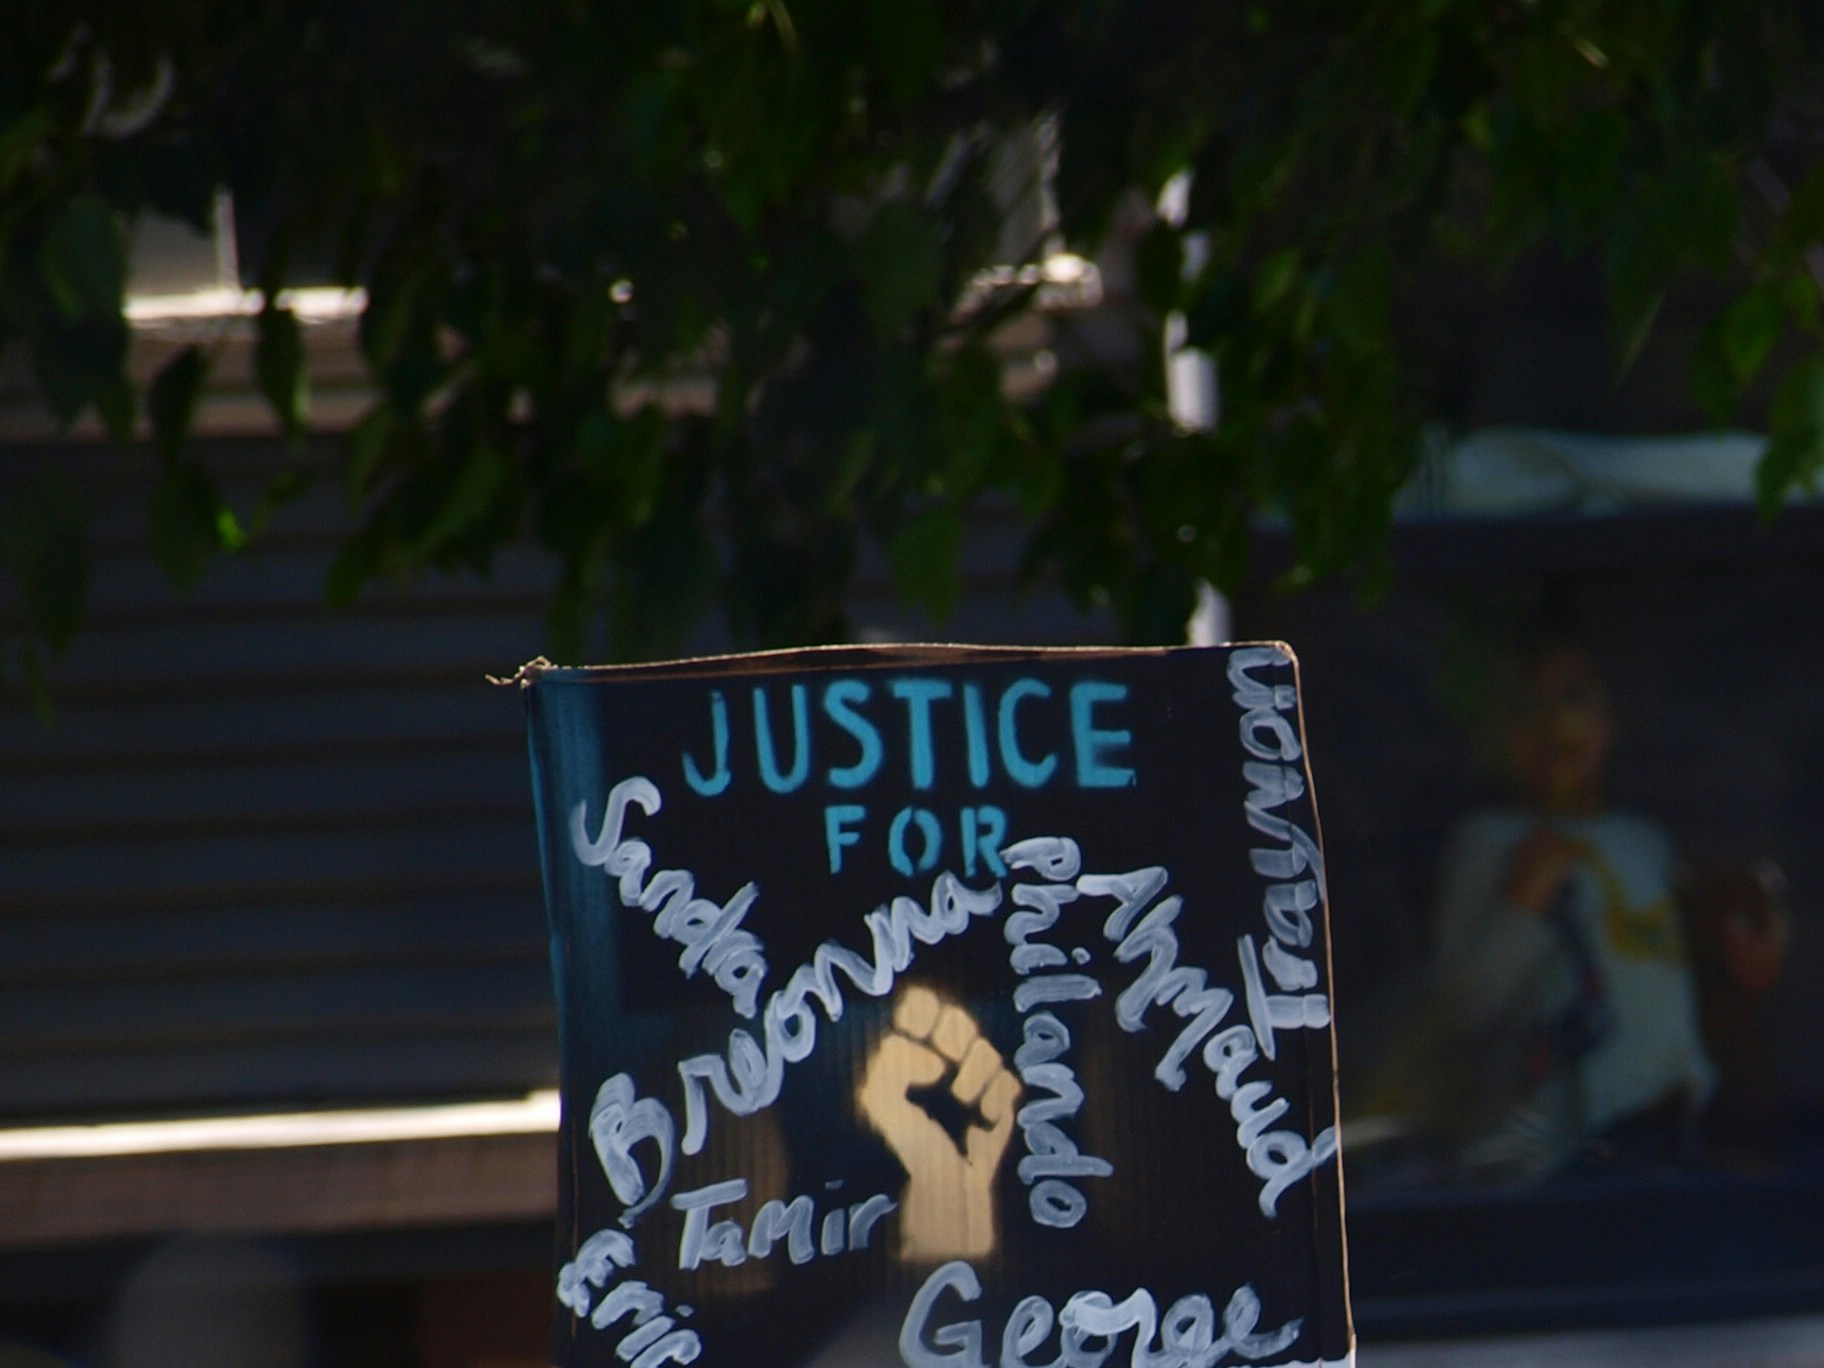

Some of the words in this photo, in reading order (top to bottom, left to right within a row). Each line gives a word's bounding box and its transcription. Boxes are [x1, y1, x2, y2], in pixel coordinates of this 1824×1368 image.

[683, 679, 1137, 797] JUSTICE
[825, 805, 1010, 878] FOR
[1226, 645, 1331, 1061] Trayvon
[571, 776, 767, 1020] Sandra
[1000, 836, 1114, 1228] Philando
[588, 872, 1003, 1222] Breonna
